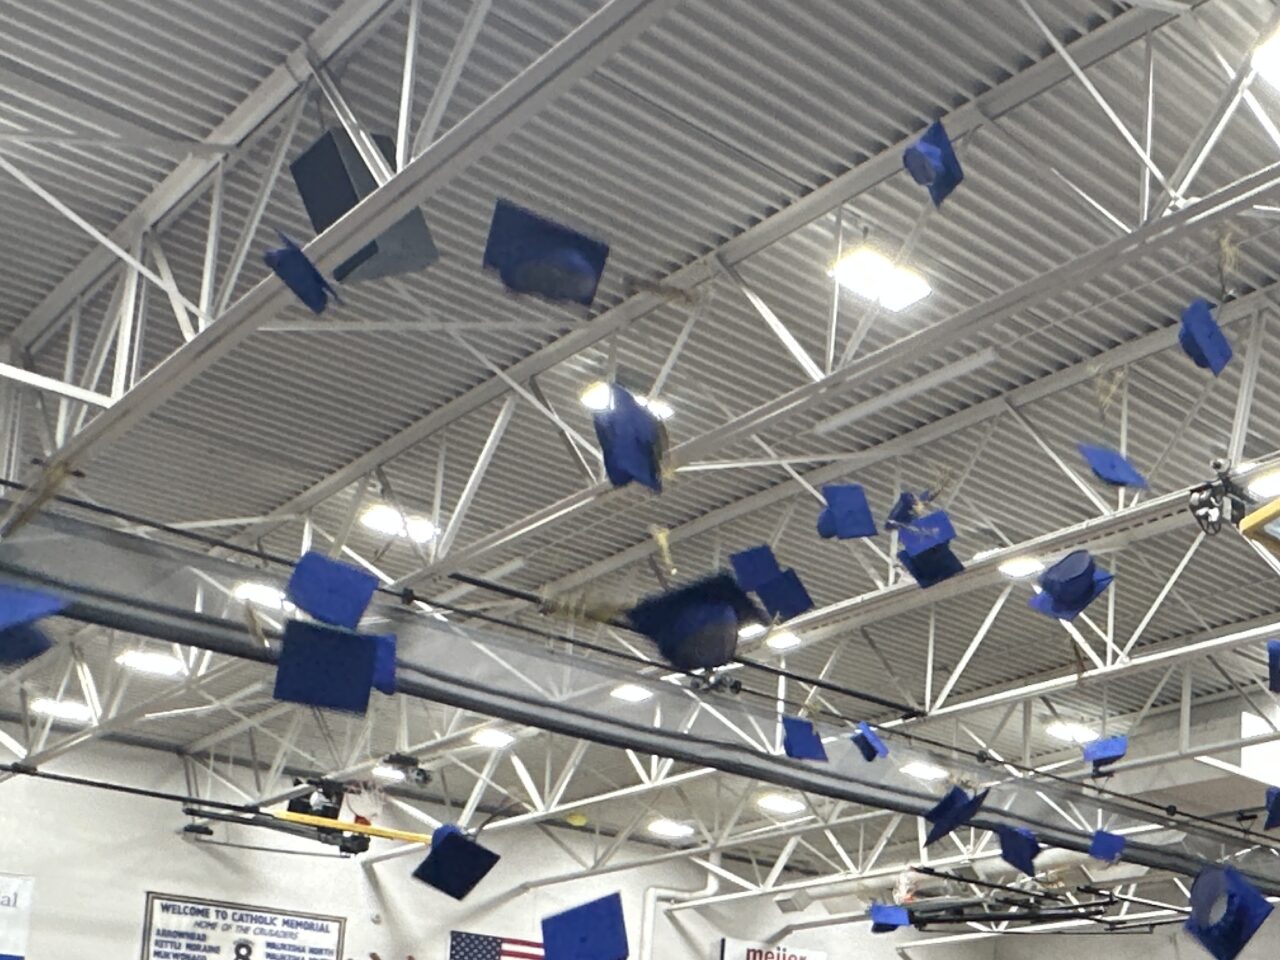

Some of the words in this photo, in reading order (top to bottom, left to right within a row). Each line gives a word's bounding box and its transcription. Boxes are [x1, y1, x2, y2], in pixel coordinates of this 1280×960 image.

[160, 902, 211, 919] WELCOME
[214, 909, 228, 921] TO
[231, 911, 278, 927] CATHOLIC
[281, 918, 330, 934] MEMORIAL
